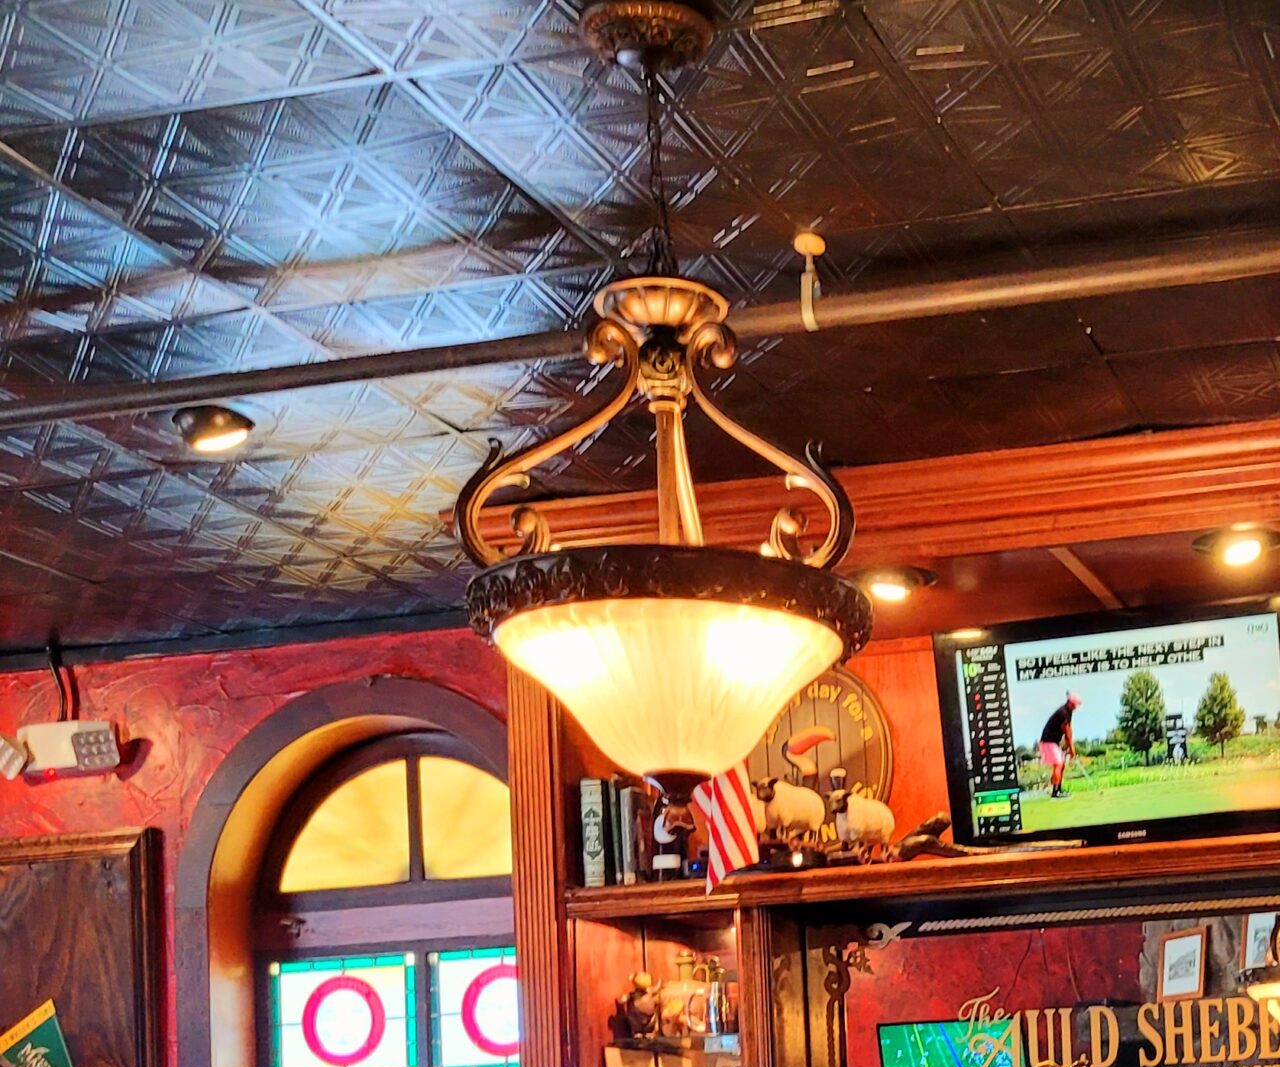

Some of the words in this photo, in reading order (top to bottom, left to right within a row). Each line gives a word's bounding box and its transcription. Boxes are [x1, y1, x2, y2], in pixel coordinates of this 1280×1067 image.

[1080, 650, 1108, 663] LIKE
[1109, 647, 1136, 660] THE
[1138, 643, 1170, 656] NEXT
[1019, 669, 1036, 681] MY
[1038, 664, 1095, 679] JOURNEY
[1113, 658, 1130, 671] TO
[1132, 653, 1165, 669] HELP
[806, 680, 842, 703] day
[957, 985, 1010, 1042] The
